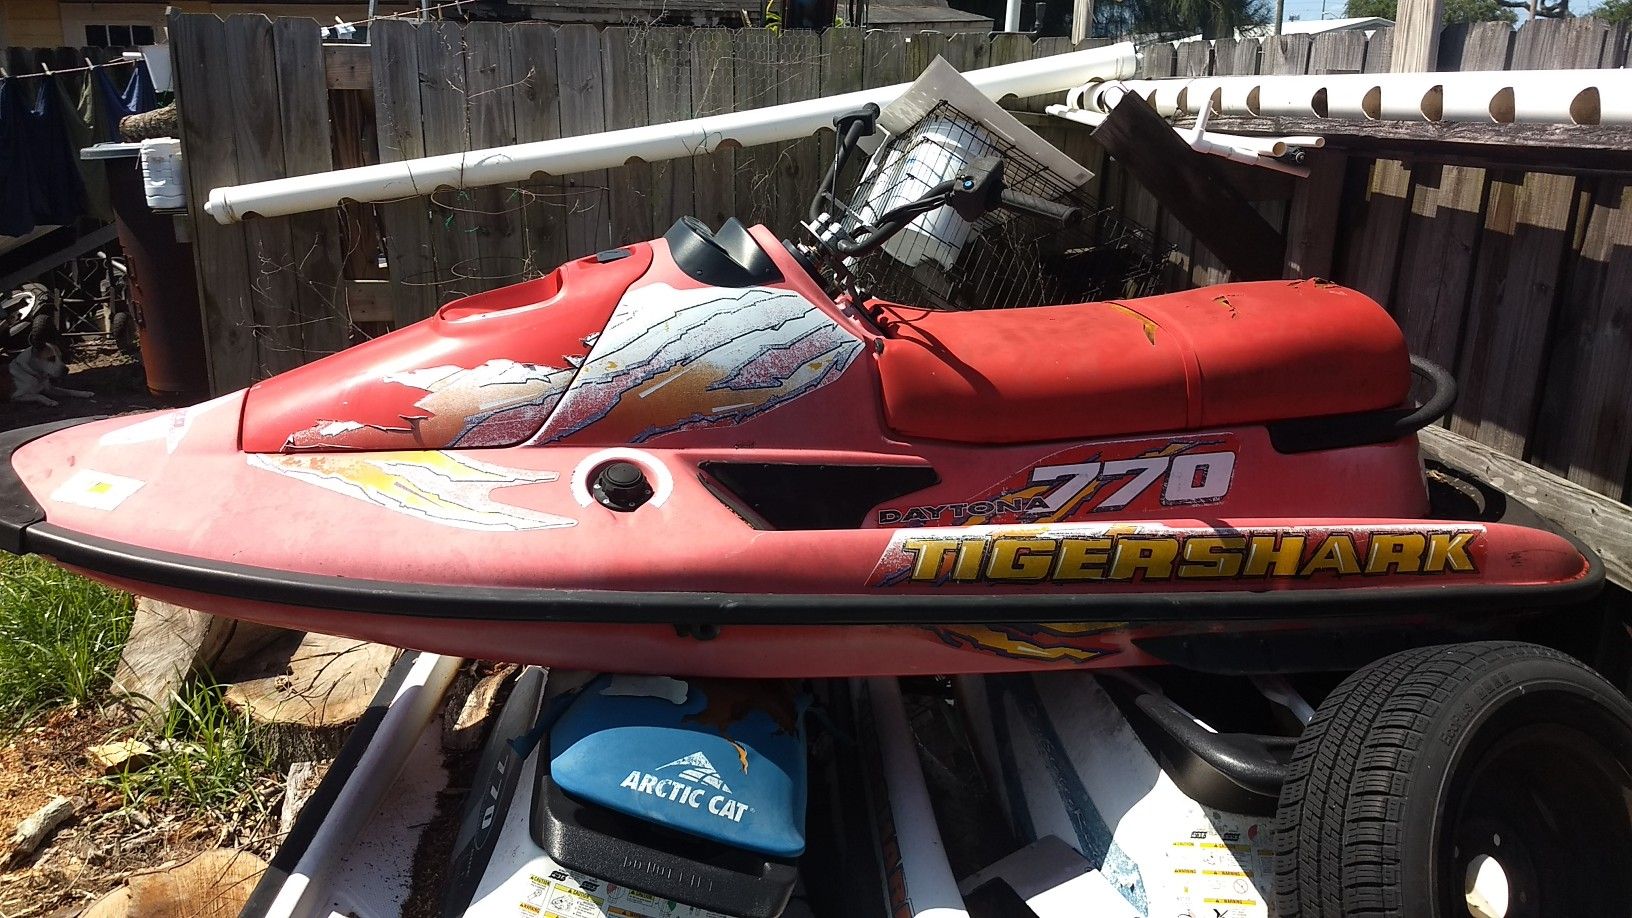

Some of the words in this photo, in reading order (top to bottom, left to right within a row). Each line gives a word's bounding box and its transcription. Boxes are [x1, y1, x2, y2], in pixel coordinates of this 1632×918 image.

[1030, 451, 1236, 514] 770
[878, 496, 1051, 525] DAYTONA
[903, 528, 1480, 583] TIGERSHARK
[620, 770, 706, 809] ARCTIC
[708, 795, 748, 823] CAT
